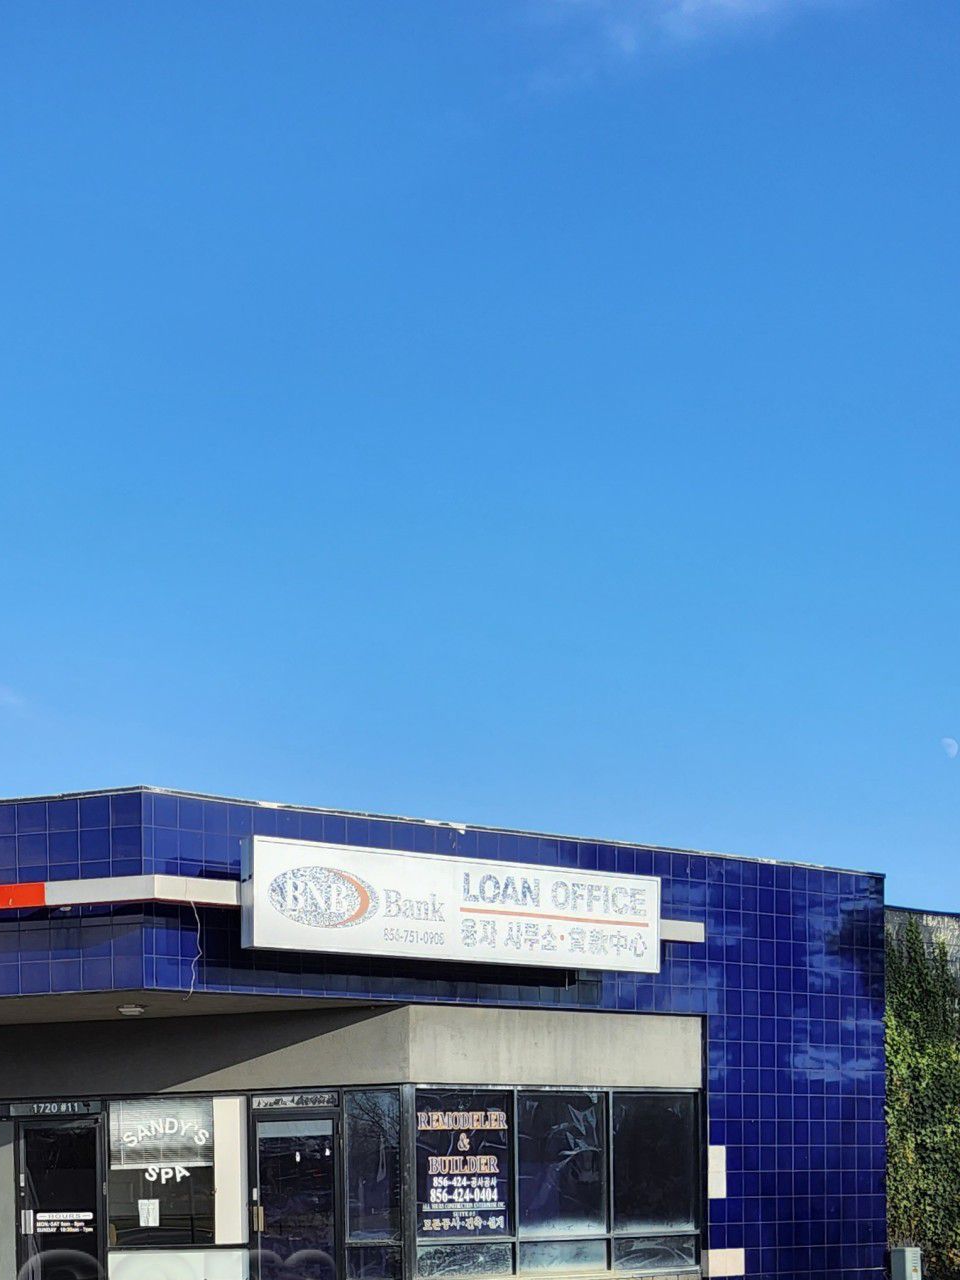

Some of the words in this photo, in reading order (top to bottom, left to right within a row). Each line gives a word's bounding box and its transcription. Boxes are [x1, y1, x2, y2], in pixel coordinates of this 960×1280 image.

[287, 877, 350, 914] BNB
[382, 888, 446, 923] Bank
[462, 871, 541, 908] LOAN
[550, 880, 648, 917] OFFICE
[32, 1103, 58, 1114] 1720
[60, 1102, 79, 1113] #11
[417, 1111, 508, 1130] REMODELER
[122, 1117, 210, 1148] SANDY'S
[457, 1132, 471, 1152] &
[144, 1164, 191, 1185] SPA
[428, 1155, 499, 1174] BUILDER
[429, 1187, 499, 1203] 856-424-0404
